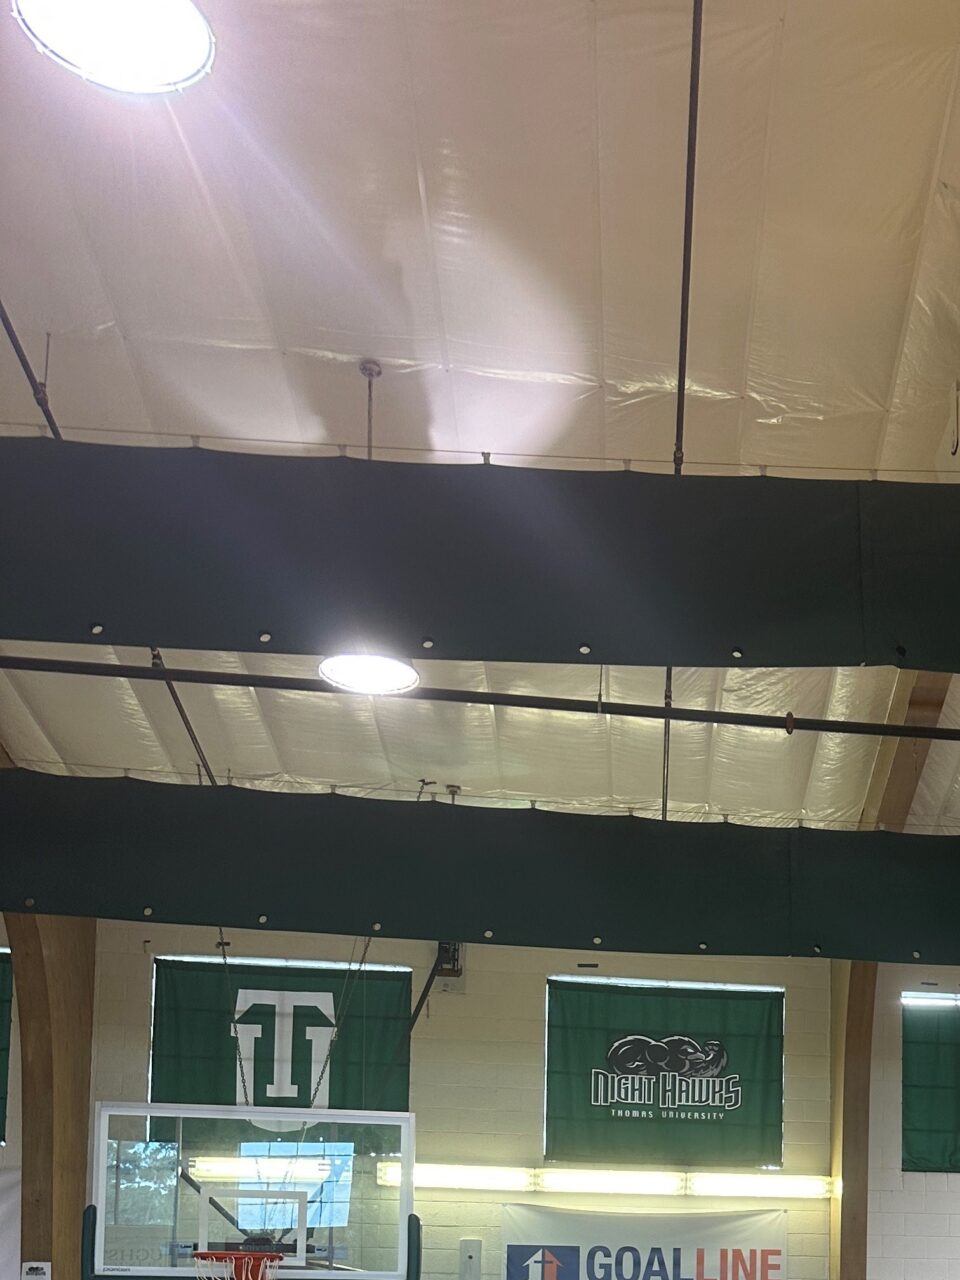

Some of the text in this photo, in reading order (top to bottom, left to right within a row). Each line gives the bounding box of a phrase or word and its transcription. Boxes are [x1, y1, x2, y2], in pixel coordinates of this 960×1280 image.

[591, 1069, 742, 1110] NIGHT HAWKS
[611, 1109, 725, 1120] THOMAS UNIVERSITY
